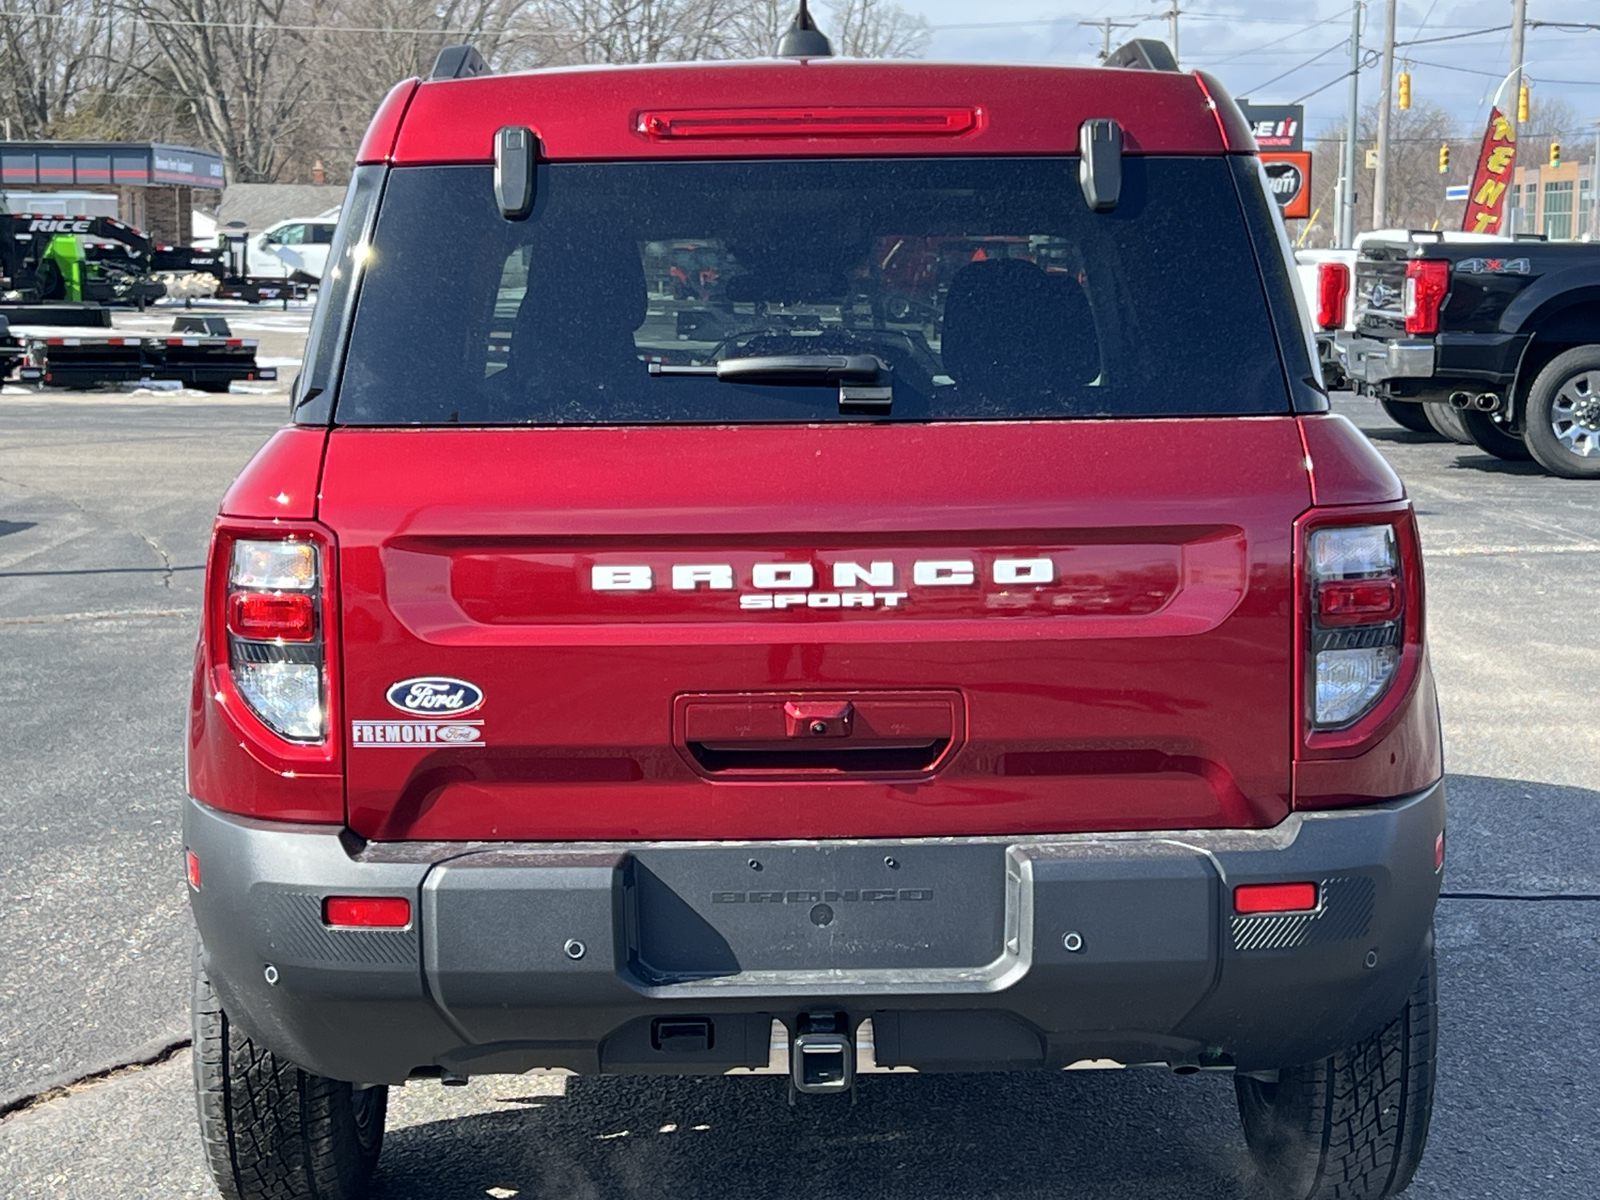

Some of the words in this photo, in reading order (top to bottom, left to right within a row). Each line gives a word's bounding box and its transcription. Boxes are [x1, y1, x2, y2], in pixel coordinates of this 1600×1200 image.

[29, 220, 91, 232] RICE
[591, 558, 1054, 591] BRONCO
[739, 592, 908, 610] SPORT
[405, 682, 465, 709] Ford
[352, 725, 438, 742] FREMONT
[445, 727, 472, 740] Ford
[710, 888, 934, 904] BRONCO
